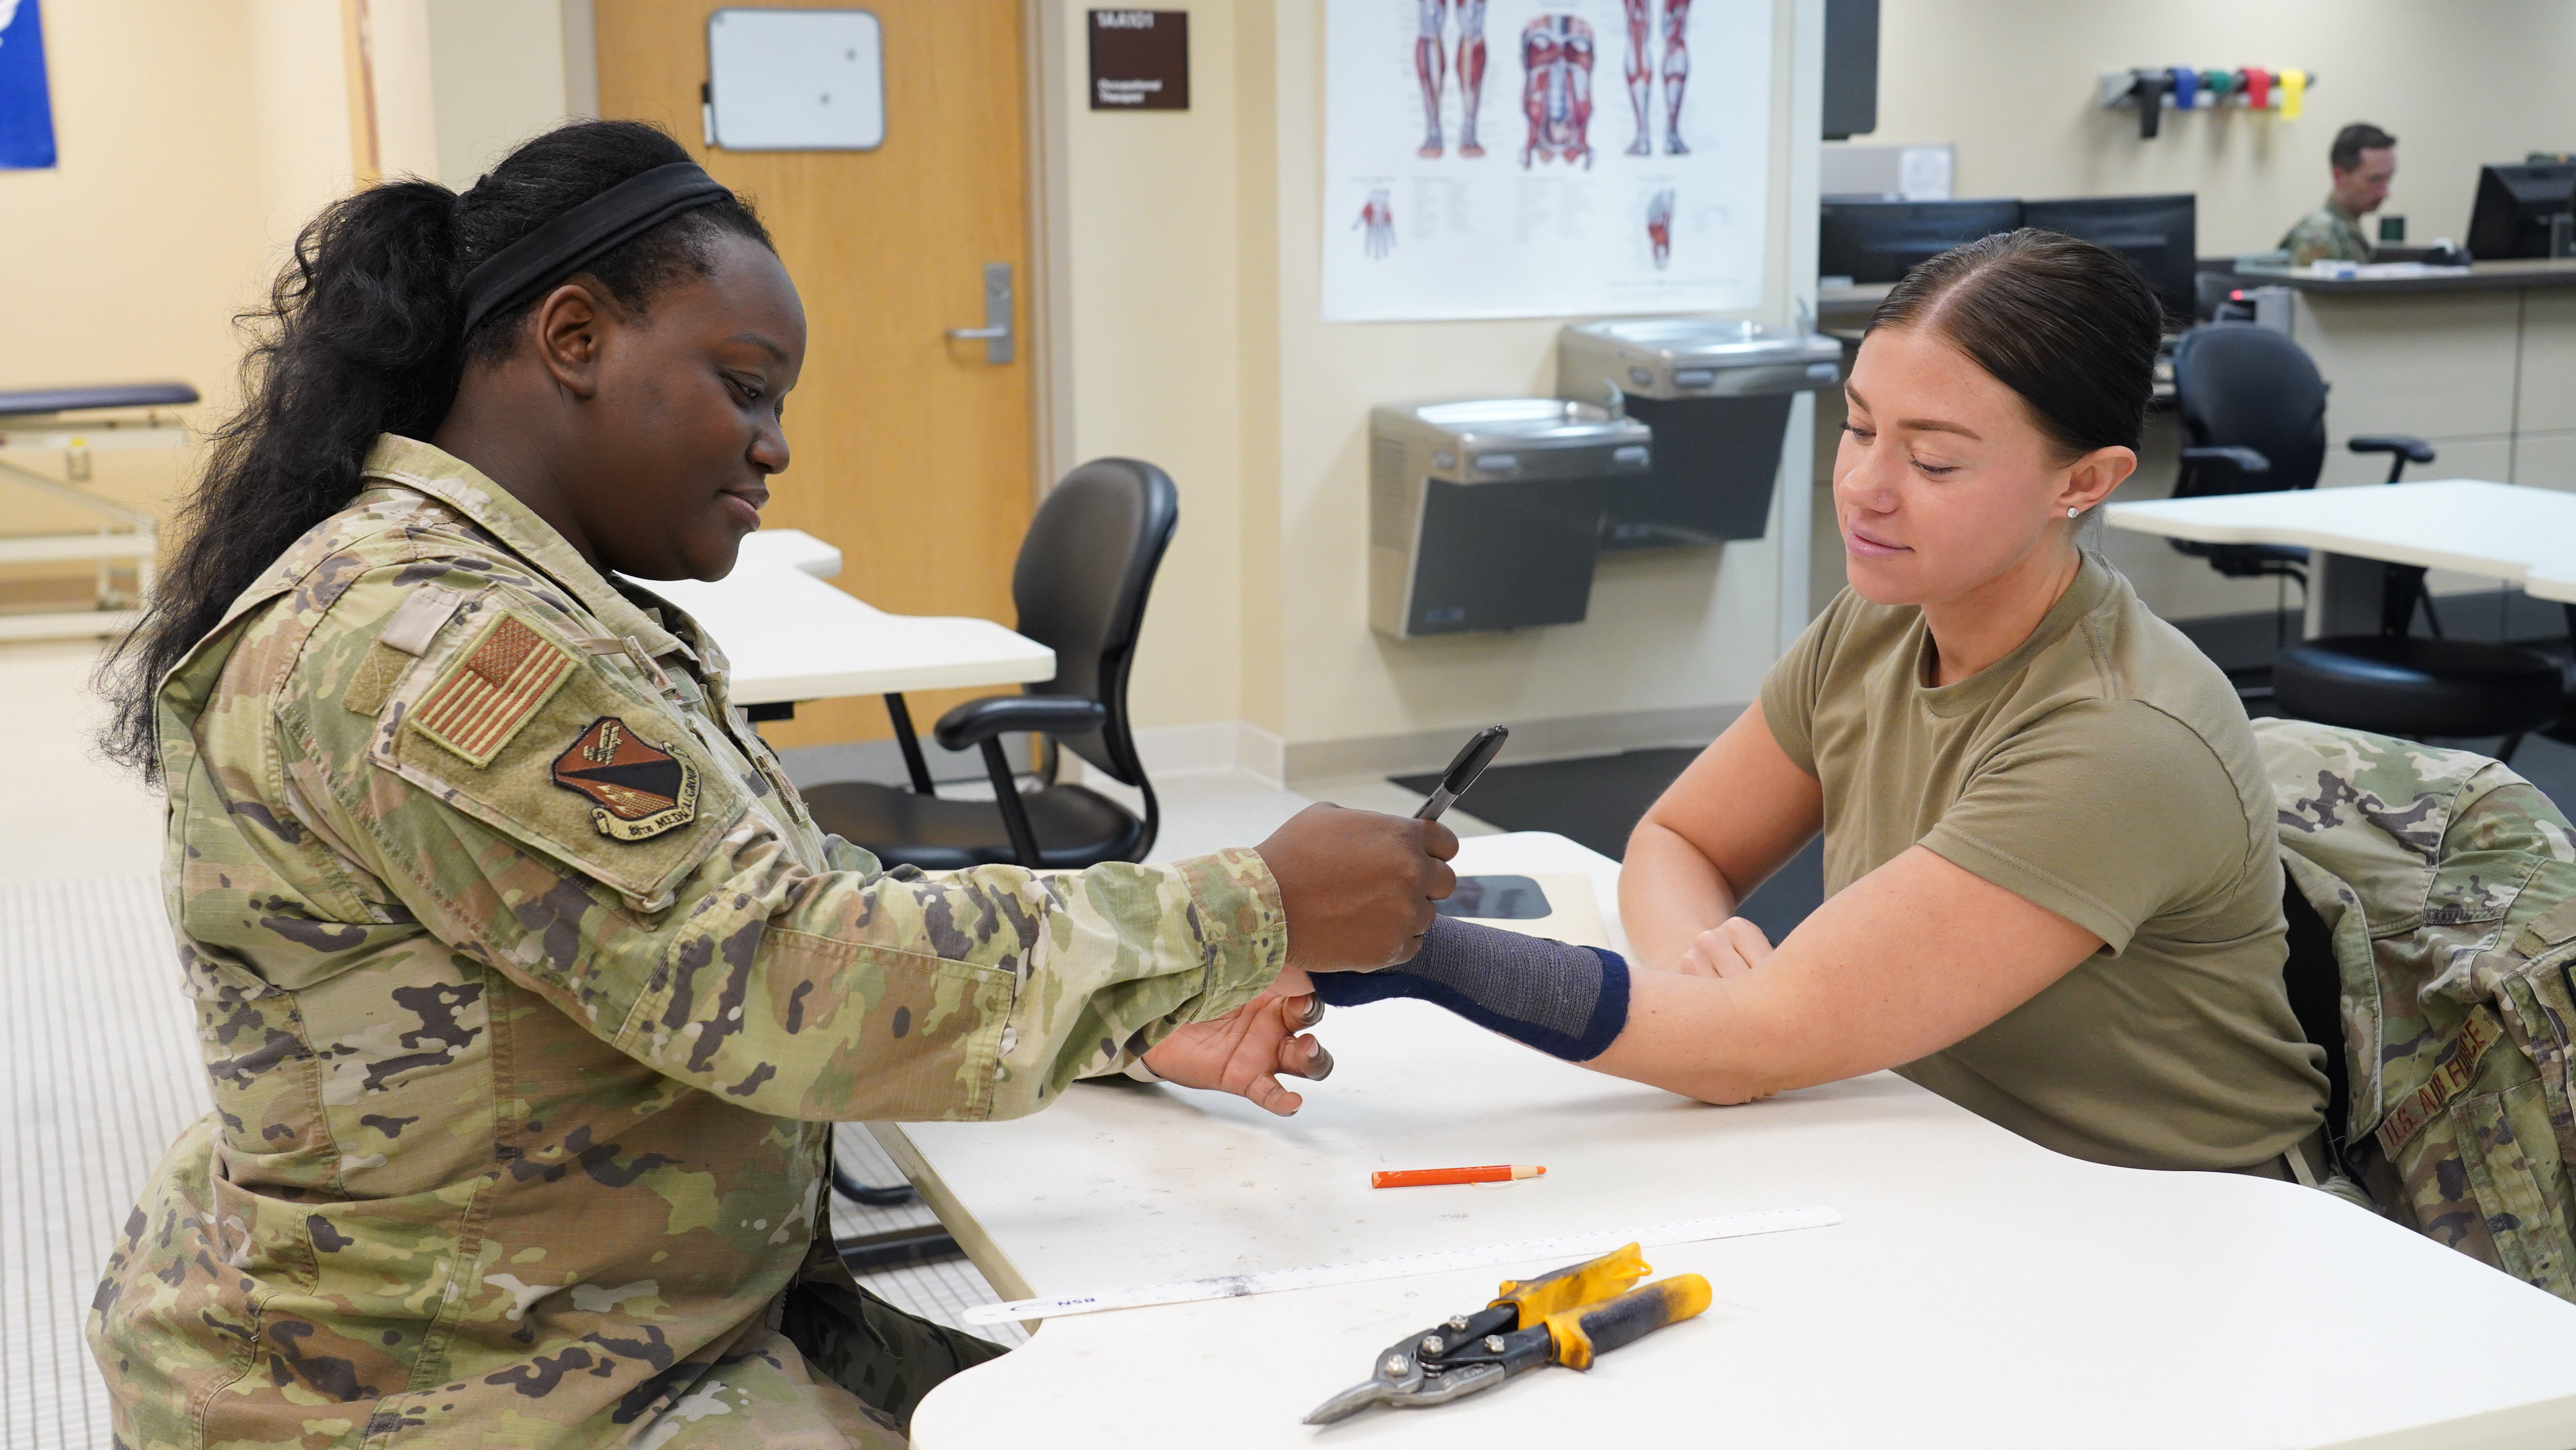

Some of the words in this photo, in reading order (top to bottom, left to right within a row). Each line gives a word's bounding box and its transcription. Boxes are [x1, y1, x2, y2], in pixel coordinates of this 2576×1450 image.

[655, 798, 692, 828] MEDICAL
[685, 765, 696, 797] GROUP
[2384, 1106, 2418, 1146] U.S.
[2418, 1072, 2448, 1116] AIR
